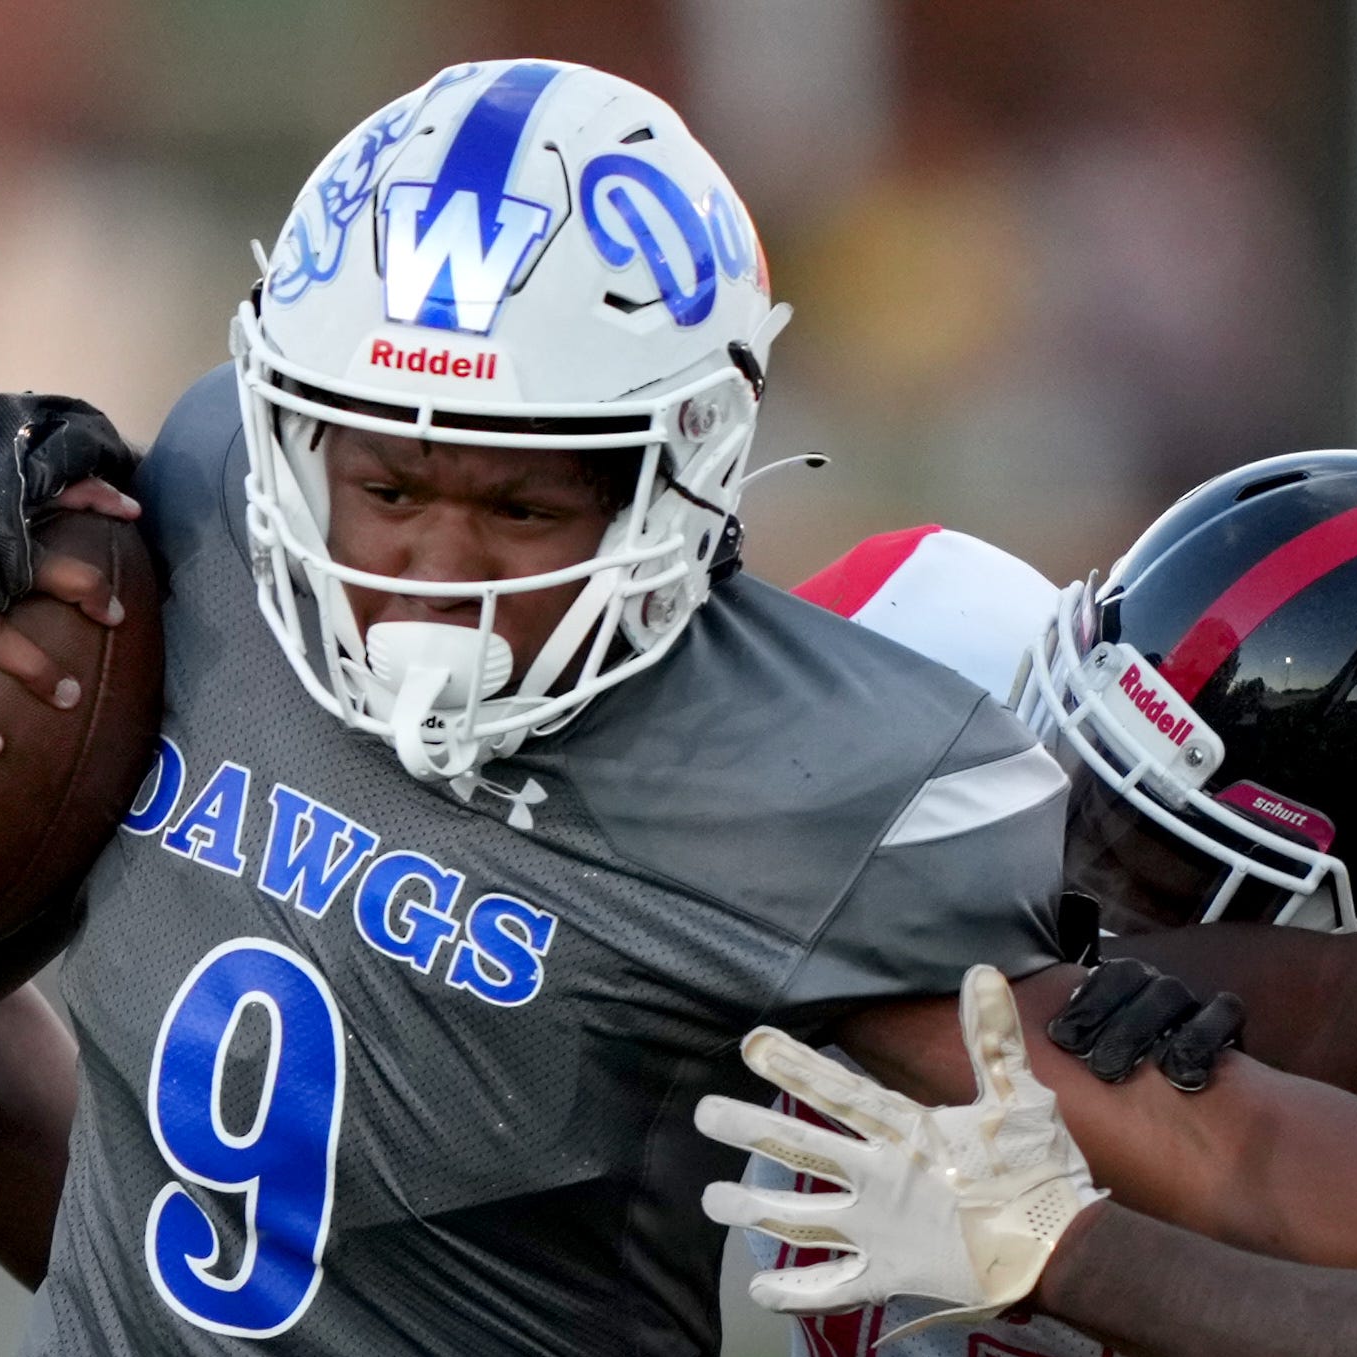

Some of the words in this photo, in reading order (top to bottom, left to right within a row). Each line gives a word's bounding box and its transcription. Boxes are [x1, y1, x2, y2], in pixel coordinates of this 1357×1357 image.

[382, 181, 552, 337] W
[371, 339, 497, 379] Riddell
[1119, 663, 1194, 746] Riddell
[145, 937, 345, 1339] 9
